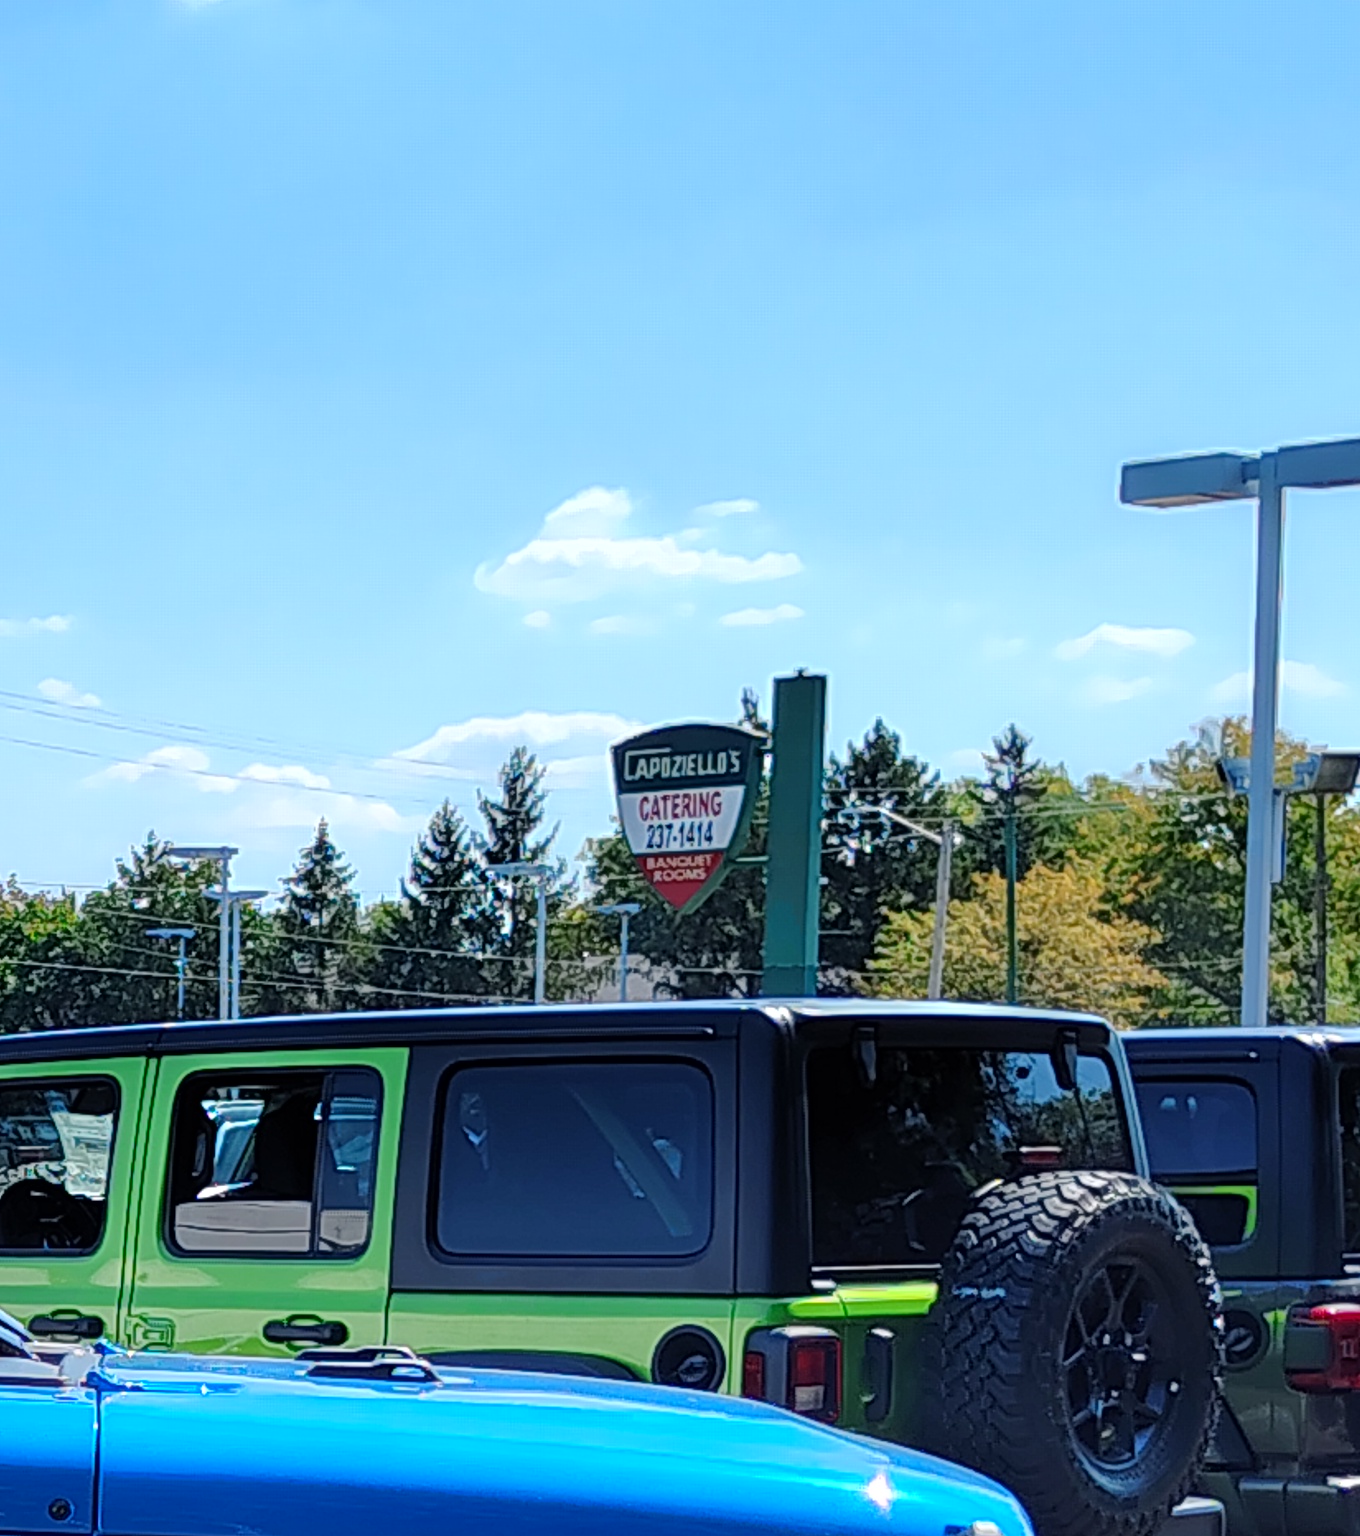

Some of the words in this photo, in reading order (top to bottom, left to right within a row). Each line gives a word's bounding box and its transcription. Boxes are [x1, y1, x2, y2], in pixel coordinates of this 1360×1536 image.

[624, 747, 742, 781] CAPOZIELLO'S
[639, 791, 722, 822] CATERING
[646, 820, 714, 850] 237-1414
[646, 854, 713, 870] BANQUET
[652, 867, 707, 883] ROOMS
